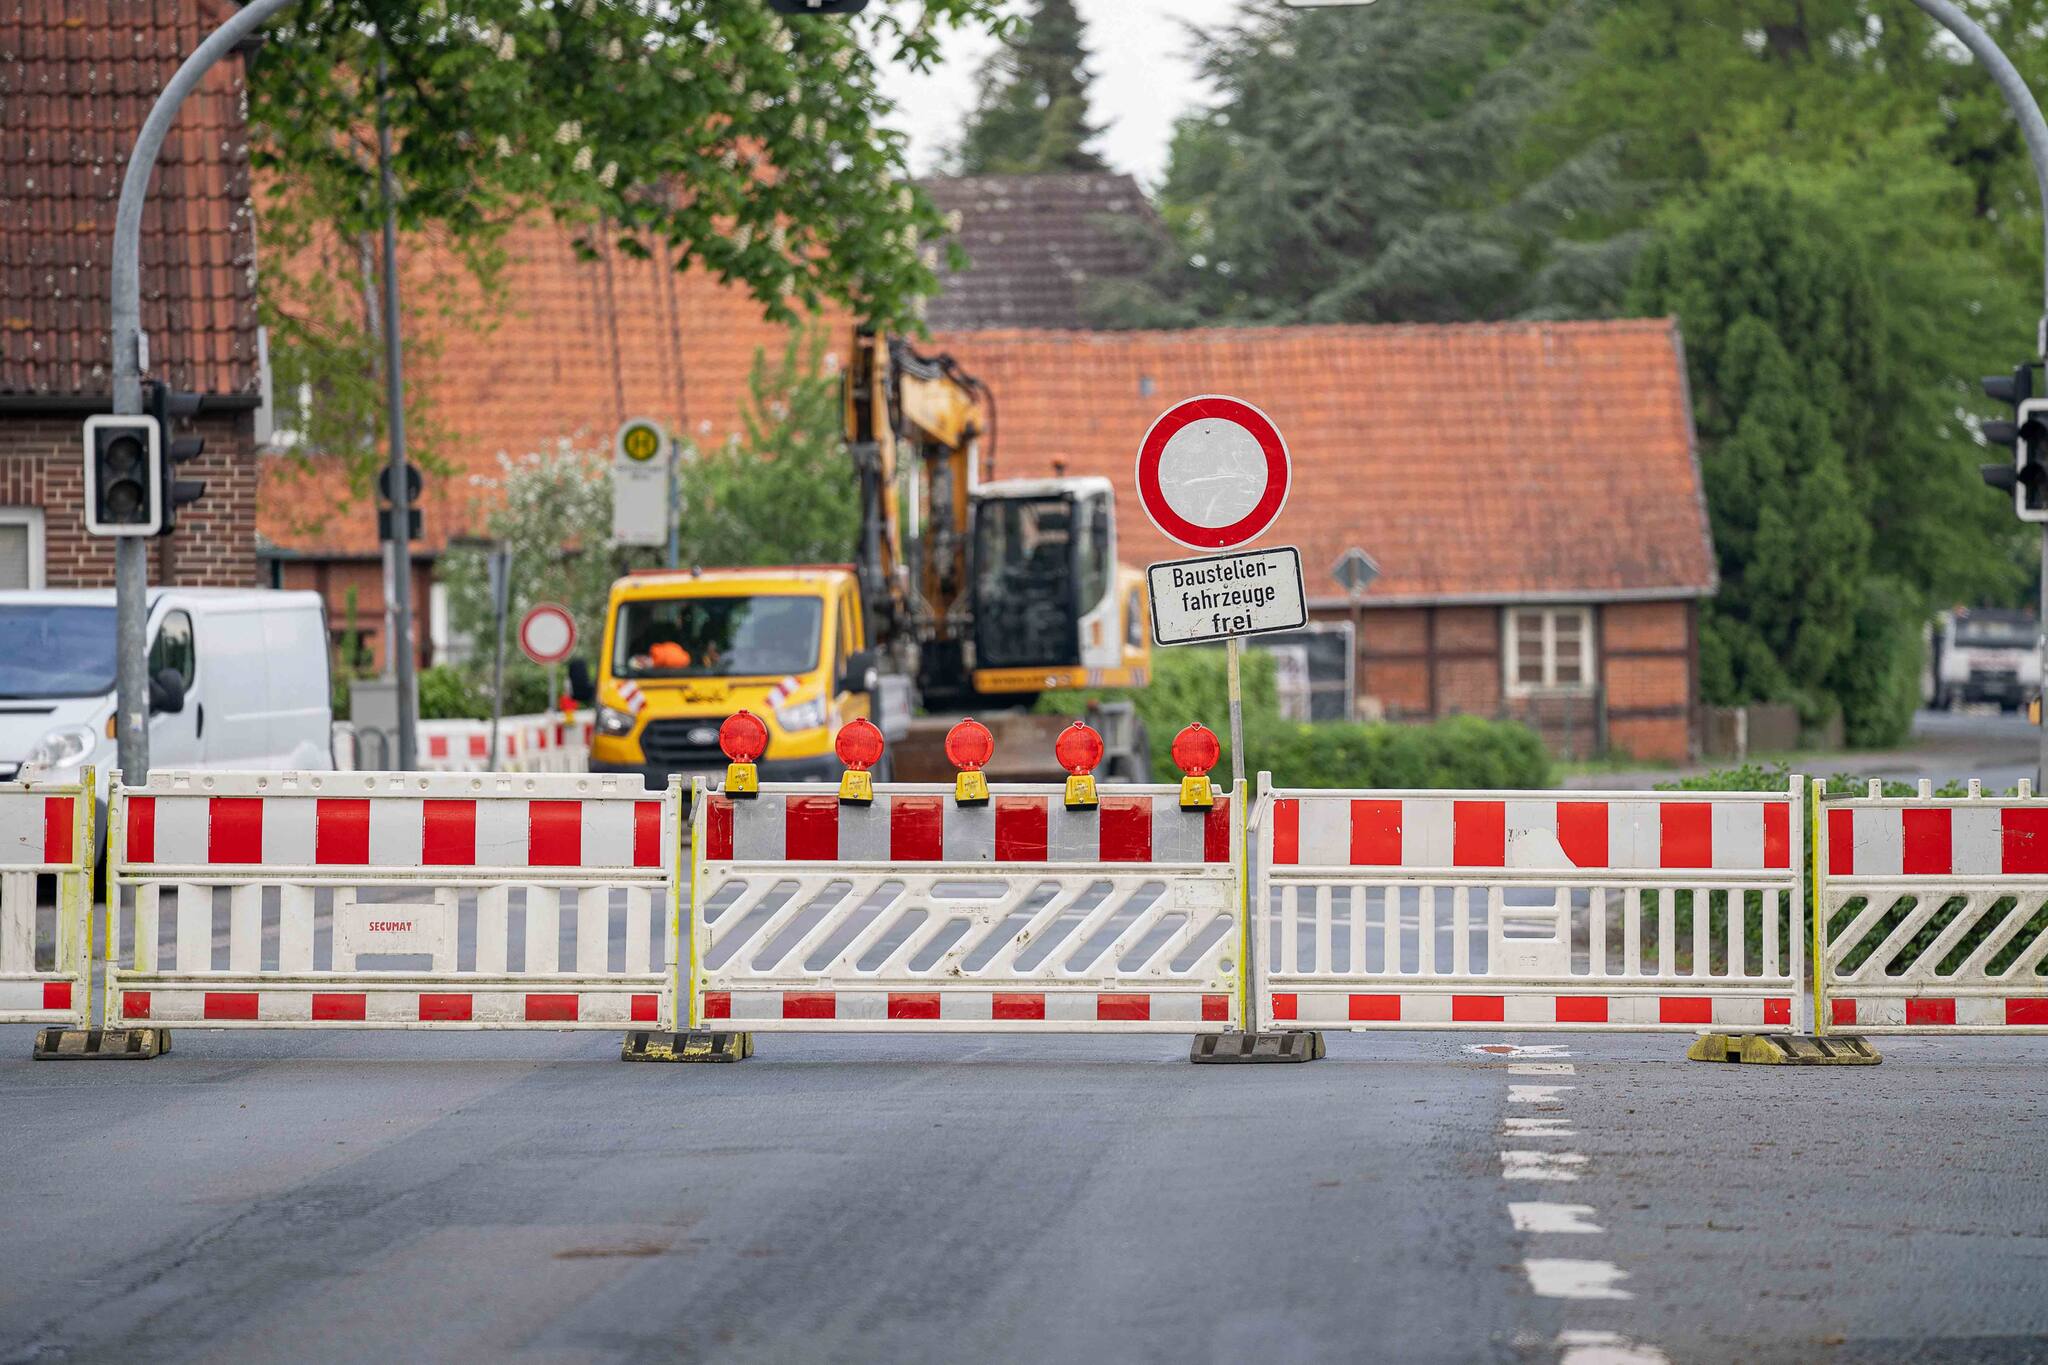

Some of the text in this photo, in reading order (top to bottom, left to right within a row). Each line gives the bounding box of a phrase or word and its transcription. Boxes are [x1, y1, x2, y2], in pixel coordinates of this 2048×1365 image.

[1173, 560, 1277, 588] Baustellen-
[1182, 585, 1275, 612] fahrzeuge
[1212, 609, 1252, 633] frei
[369, 921, 412, 931] SECUMAT
